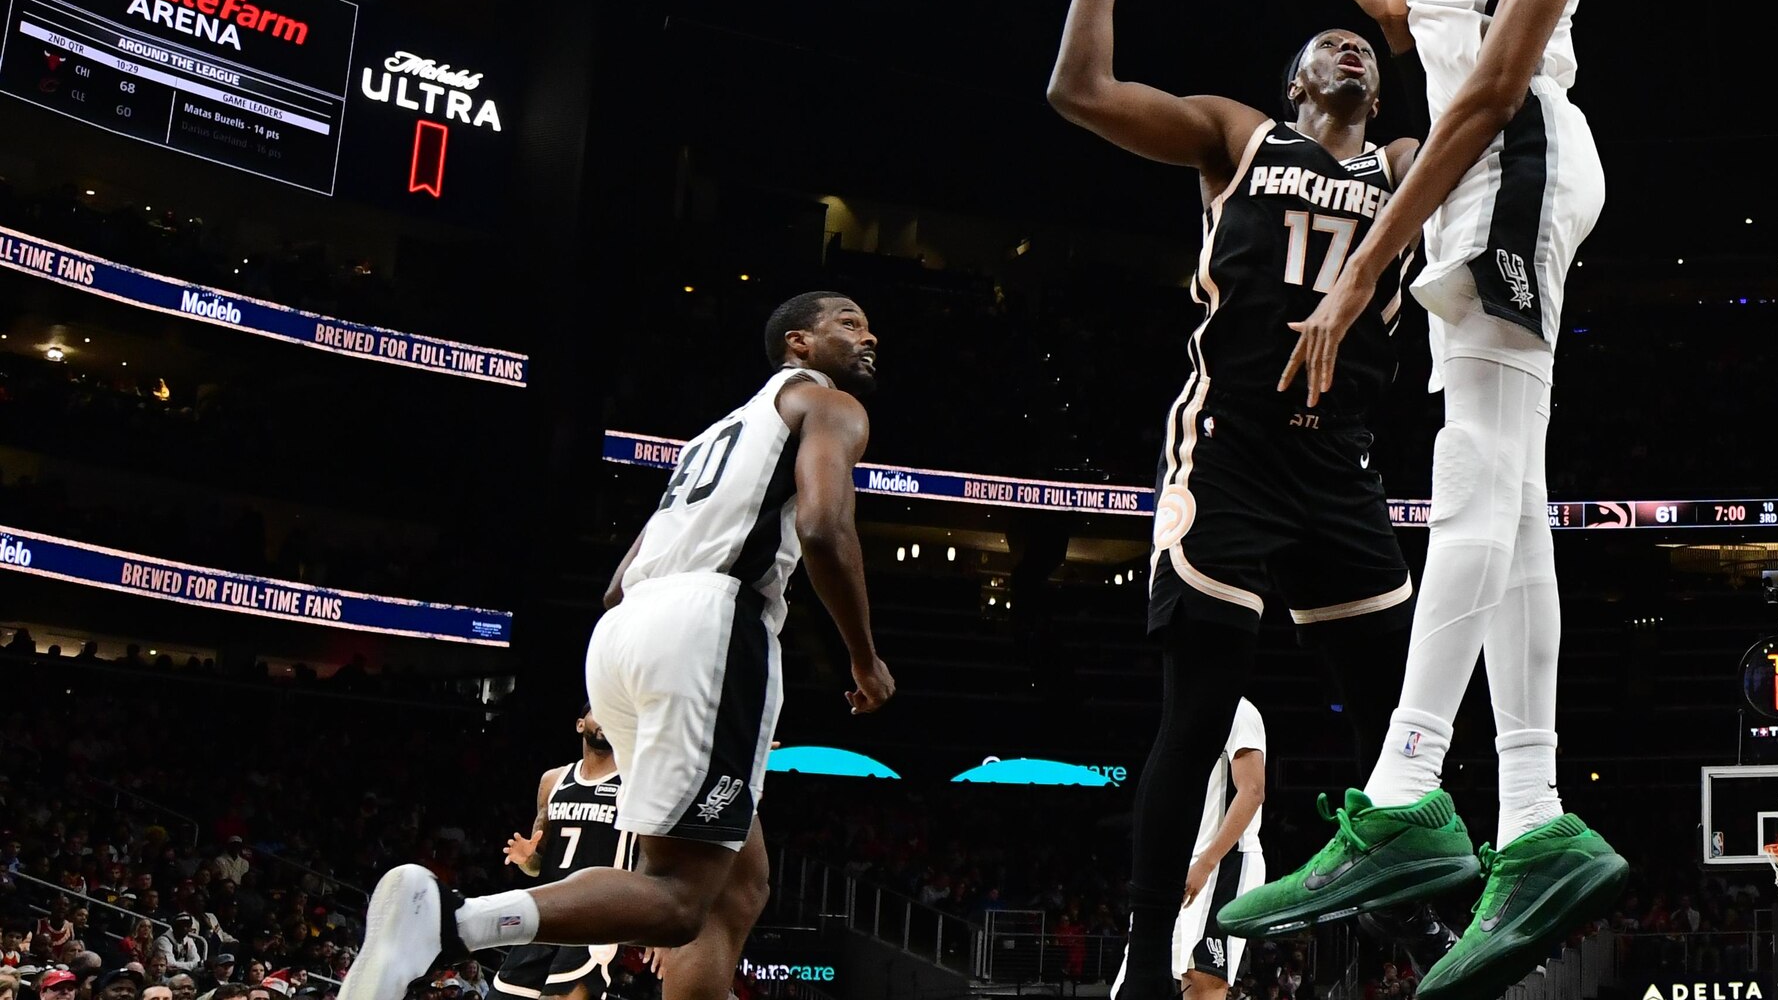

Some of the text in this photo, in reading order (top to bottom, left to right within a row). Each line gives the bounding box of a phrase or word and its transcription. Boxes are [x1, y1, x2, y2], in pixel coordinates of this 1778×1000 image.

[48, 33, 85, 54] 2ND QTR
[75, 65, 90, 78] CHI
[116, 59, 139, 74] 10:29
[117, 37, 240, 86] AROUND THE LEAGUE
[71, 89, 86, 103] CLE
[119, 80, 136, 94] 68
[116, 104, 132, 118] 60
[222, 93, 283, 119] GAME LEADERS
[362, 67, 502, 132] ULTRA
[184, 102, 280, 141] Matas Buzelis 14 pts
[0, 237, 95, 286] LL-TIME FANS
[1284, 210, 1359, 294] 17
[180, 290, 241, 324] Modelo
[315, 323, 523, 381] BREWED FOR FULL-TIME FANS
[635, 442, 681, 465] BREWE
[657, 420, 744, 512] 40
[868, 470, 919, 494] Modelo
[964, 480, 1138, 510] BREWED FOR FULL-TIME FANS
[1408, 506, 1430, 522] FAN
[1563, 505, 1570, 516] 2
[1655, 505, 1678, 523] 61
[1714, 505, 1746, 521] 7:00
[1759, 513, 1777, 523] 3RD
[1763, 502, 1774, 513] 10
[1563, 516, 1570, 526] 5
[121, 562, 342, 621] BREWED FOR FULL-TIME FANS
[559, 827, 581, 868] 7
[736, 958, 835, 981] harecare
[1672, 981, 1763, 1000] DELTA
